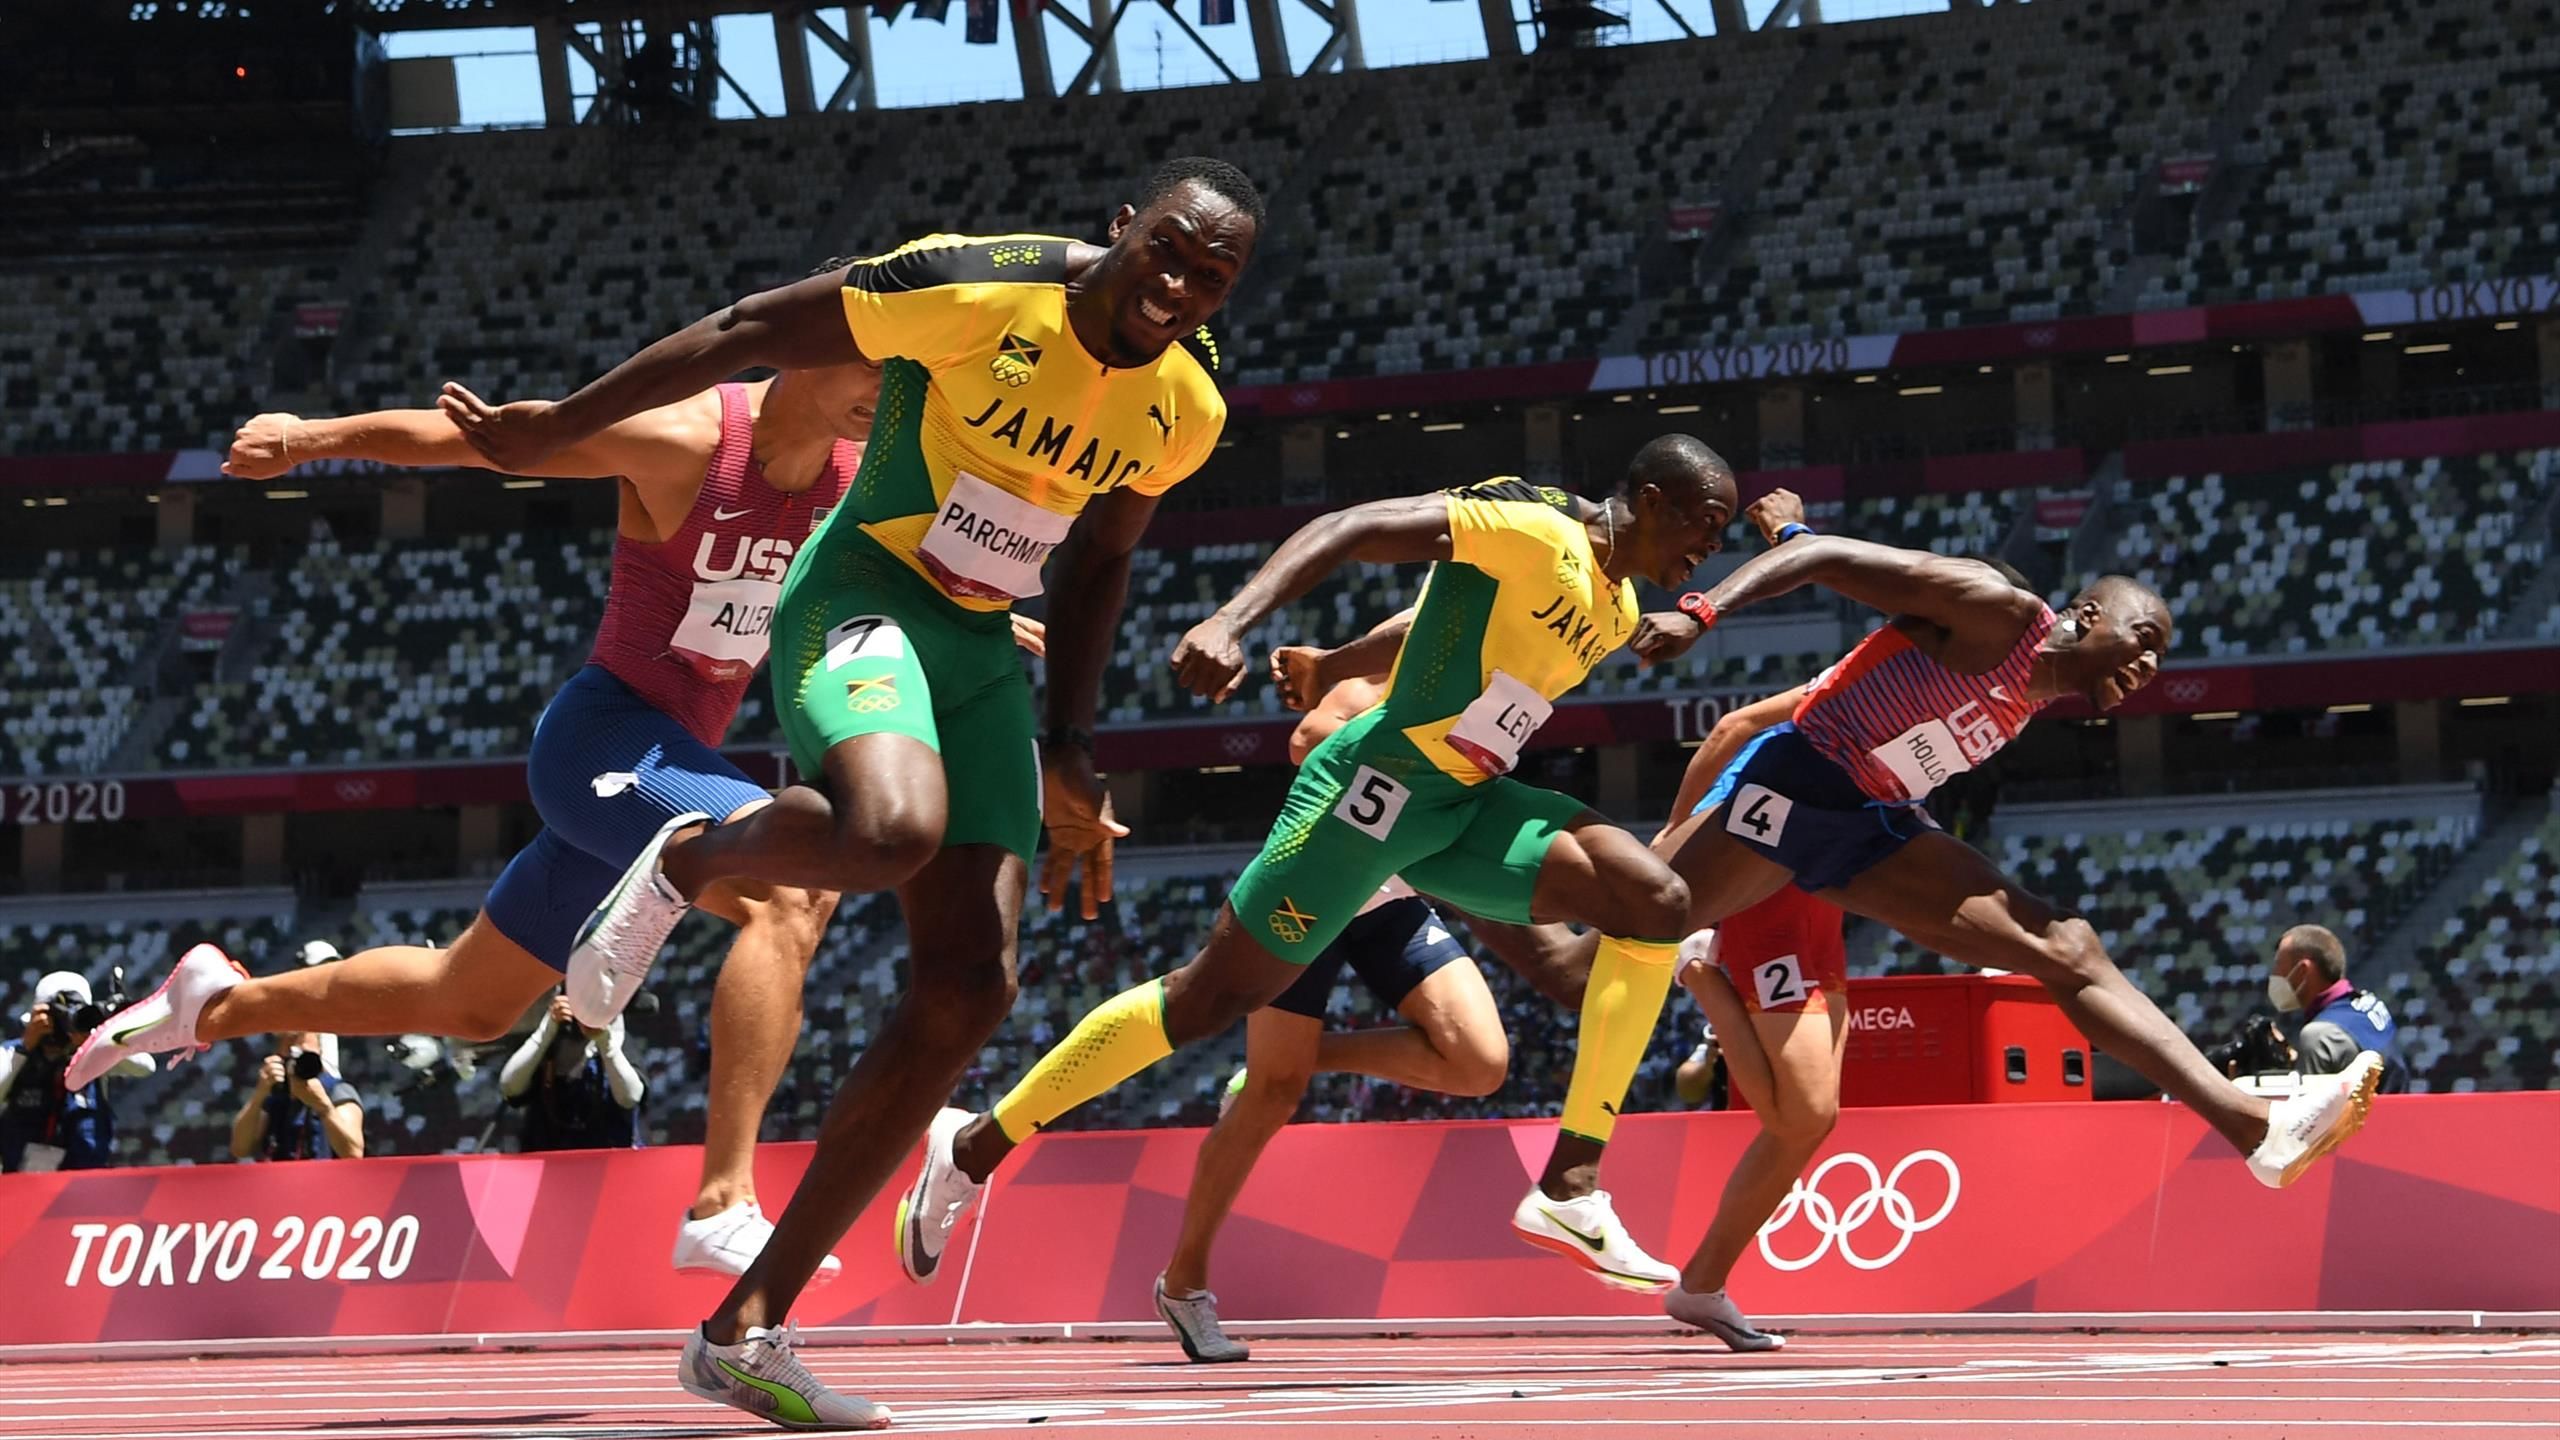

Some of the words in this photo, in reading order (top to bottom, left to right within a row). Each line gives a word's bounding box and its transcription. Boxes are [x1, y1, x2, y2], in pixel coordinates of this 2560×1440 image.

[2407, 276, 2534, 323] TOKYO
[1638, 344, 1753, 389] TOKYO
[1765, 336, 1848, 379] 2020
[692, 531, 794, 584] US
[841, 618, 883, 655] 7
[1495, 703, 1538, 744] LEV
[17, 780, 125, 825] 2020
[1350, 775, 1394, 826] 5
[1741, 794, 1773, 837] 4
[1764, 963, 1795, 1002] 2
[1850, 1006, 1915, 1031] MEGA
[65, 1217, 259, 1288] TOKYO
[257, 1214, 420, 1281] 2020
